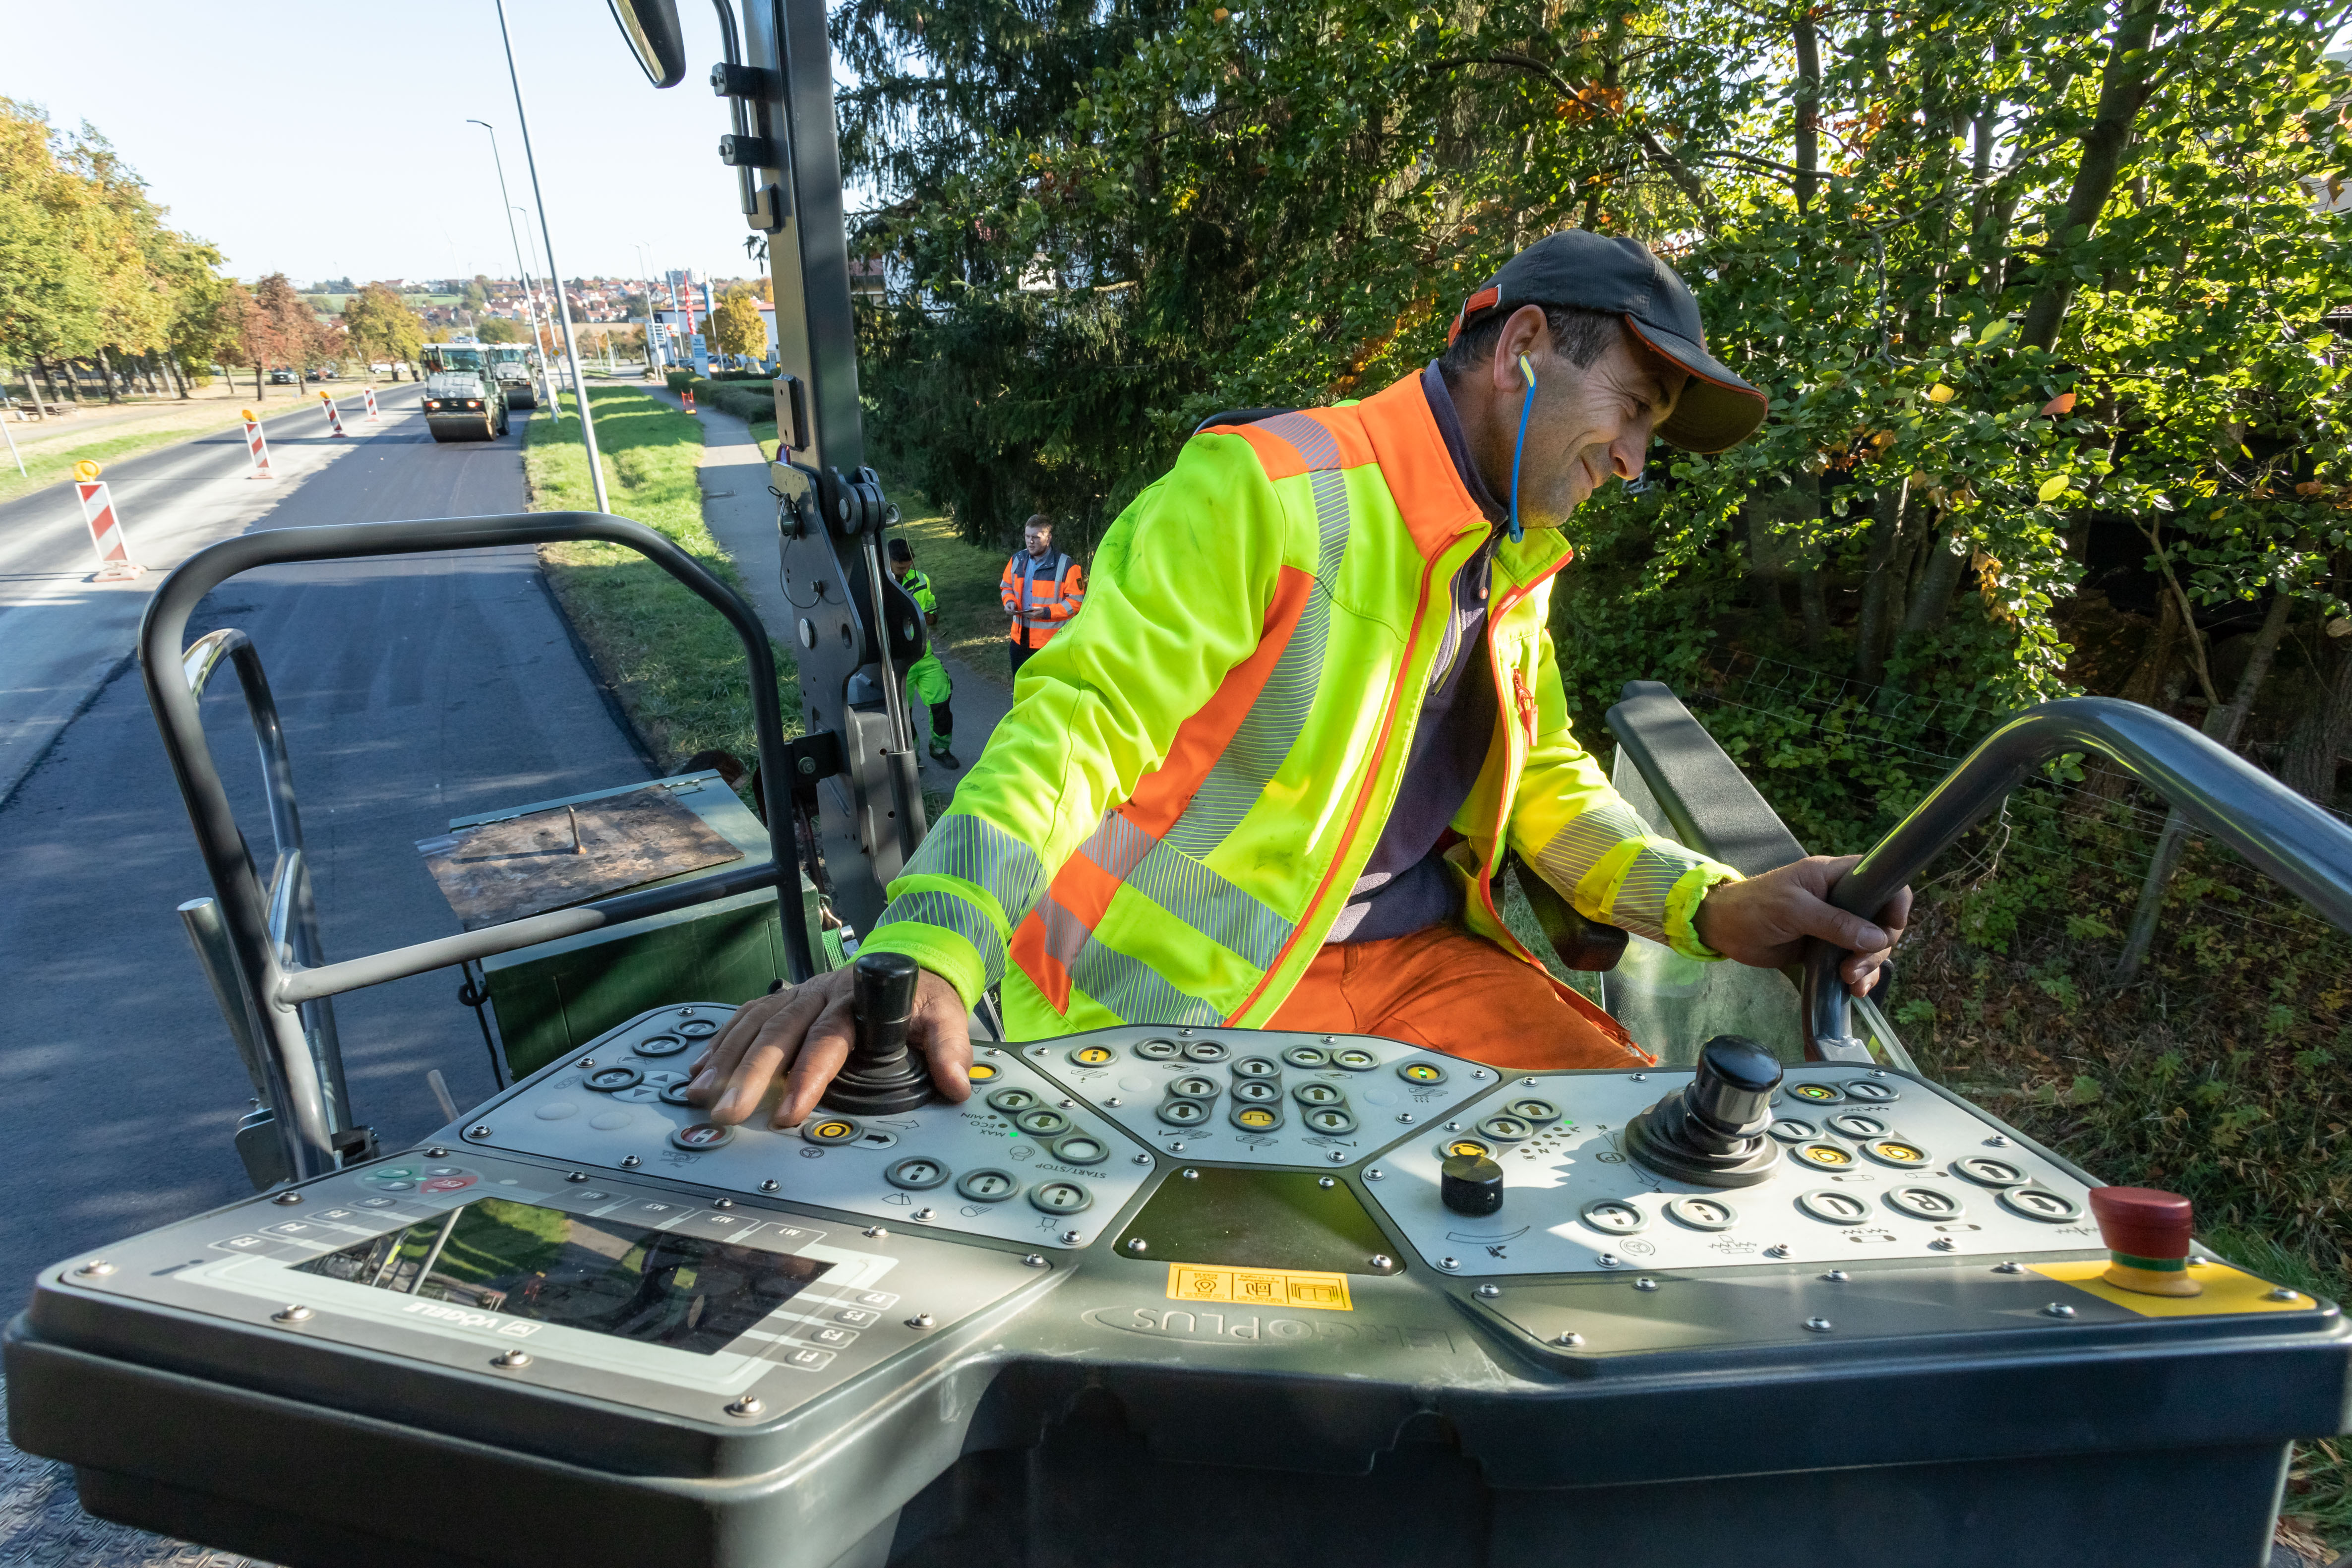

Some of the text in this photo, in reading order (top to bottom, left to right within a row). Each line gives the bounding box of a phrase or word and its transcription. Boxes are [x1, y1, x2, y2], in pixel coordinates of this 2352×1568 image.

[1035, 1163, 1106, 1178] START/STOP
[645, 1203, 668, 1211] M3
[1905, 1195, 1944, 1211] R
[711, 1215, 734, 1223] M2
[778, 1227, 800, 1236] M1
[863, 1293, 886, 1303] F7
[402, 1302, 499, 1328] VÖGELE
[843, 1311, 866, 1321] F5
[821, 1329, 844, 1341] F3
[795, 1350, 819, 1362] F1
